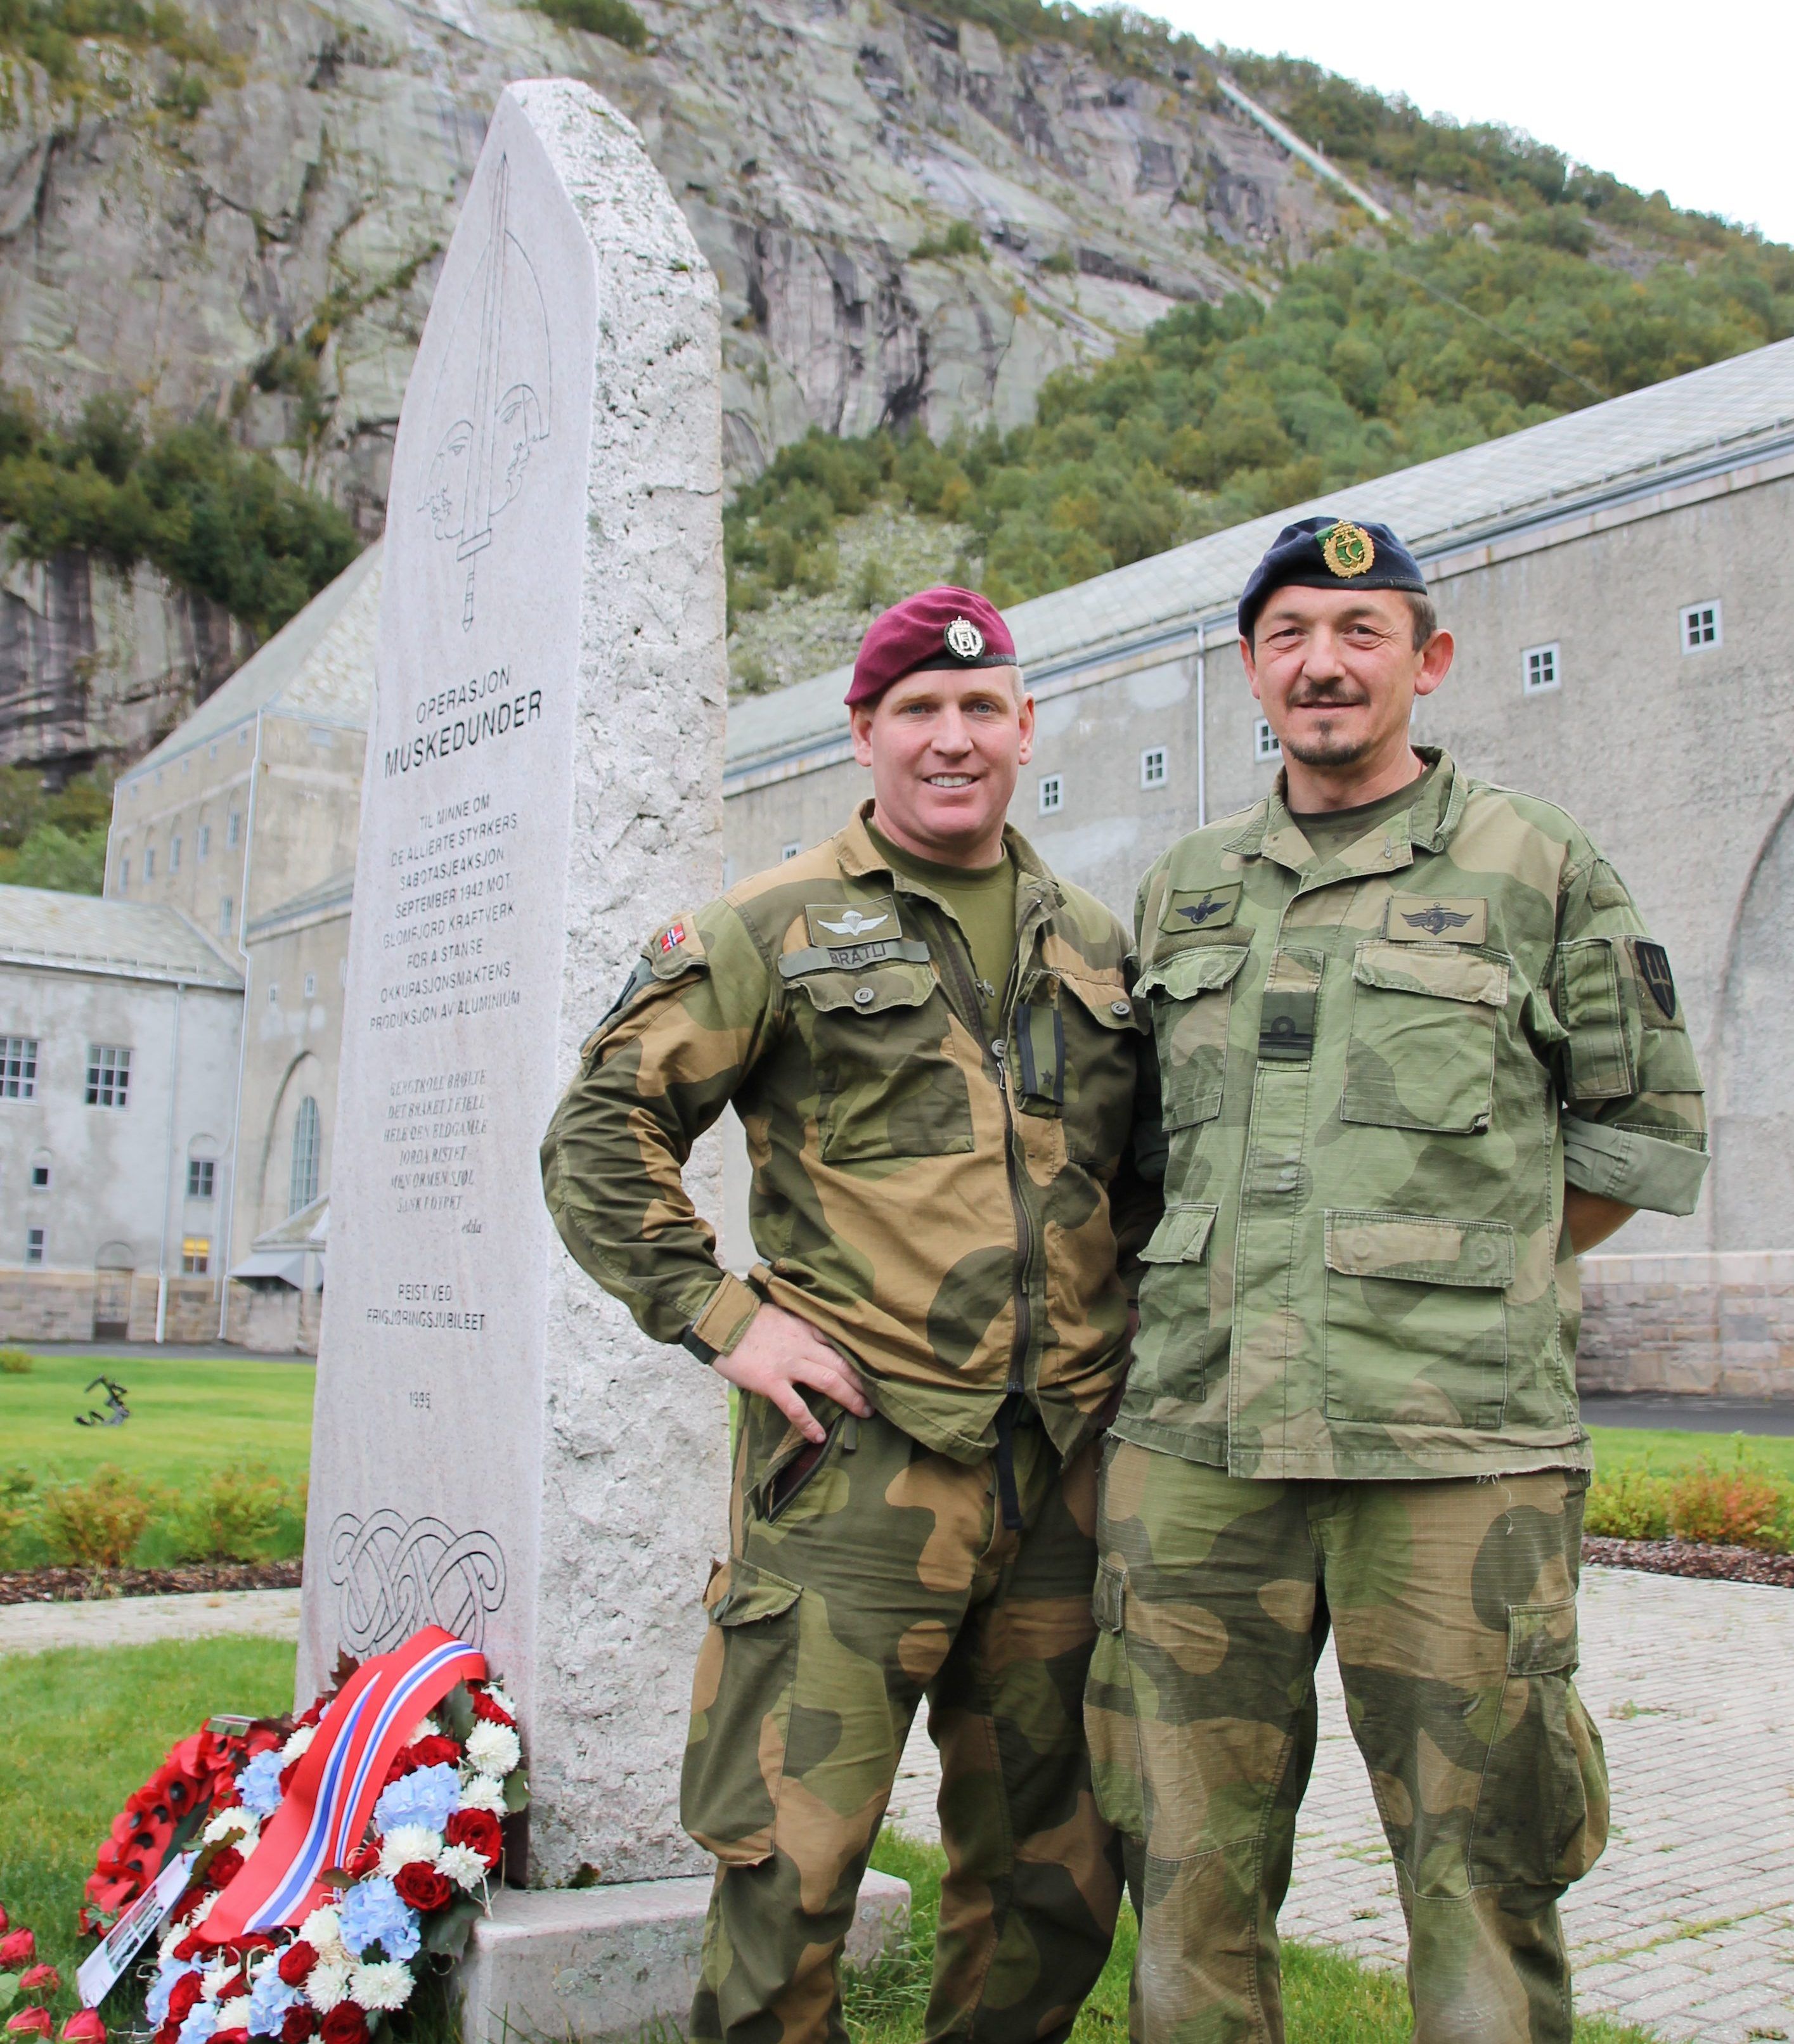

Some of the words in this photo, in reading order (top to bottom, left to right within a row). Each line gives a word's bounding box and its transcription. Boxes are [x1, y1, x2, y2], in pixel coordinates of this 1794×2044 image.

[416, 664, 510, 724] OPERASJON
[385, 690, 541, 779] MUSKEDUNDER
[420, 816, 434, 832] TIL
[437, 800, 469, 825] MINNE
[472, 794, 489, 814] OM
[391, 851, 404, 868] DE
[406, 833, 455, 862] ALLIERTE
[458, 813, 517, 846] STYRKERS
[399, 847, 504, 890] SABOTASJEAKSJON
[395, 889, 456, 919] SEPTEMBER
[460, 881, 483, 902] 1942
[486, 873, 511, 895] MOT
[383, 920, 444, 949] GLOMFJORD
[448, 901, 515, 932] KRAFTVERK
[407, 952, 427, 969] FOR
[441, 938, 483, 963] STANSE
[829, 943, 886, 966] BRATLI
[380, 961, 510, 1003] OKKUPASJONSMAKTENS
[370, 1005, 437, 1031] PRODUKSJON
[441, 1002, 455, 1018] AV
[457, 990, 520, 1015] ALUMINIUM
[398, 1284, 427, 1300] REIST
[431, 1285, 452, 1301] VED
[366, 1309, 485, 1331] FRIGJØRINGSJUBILEET
